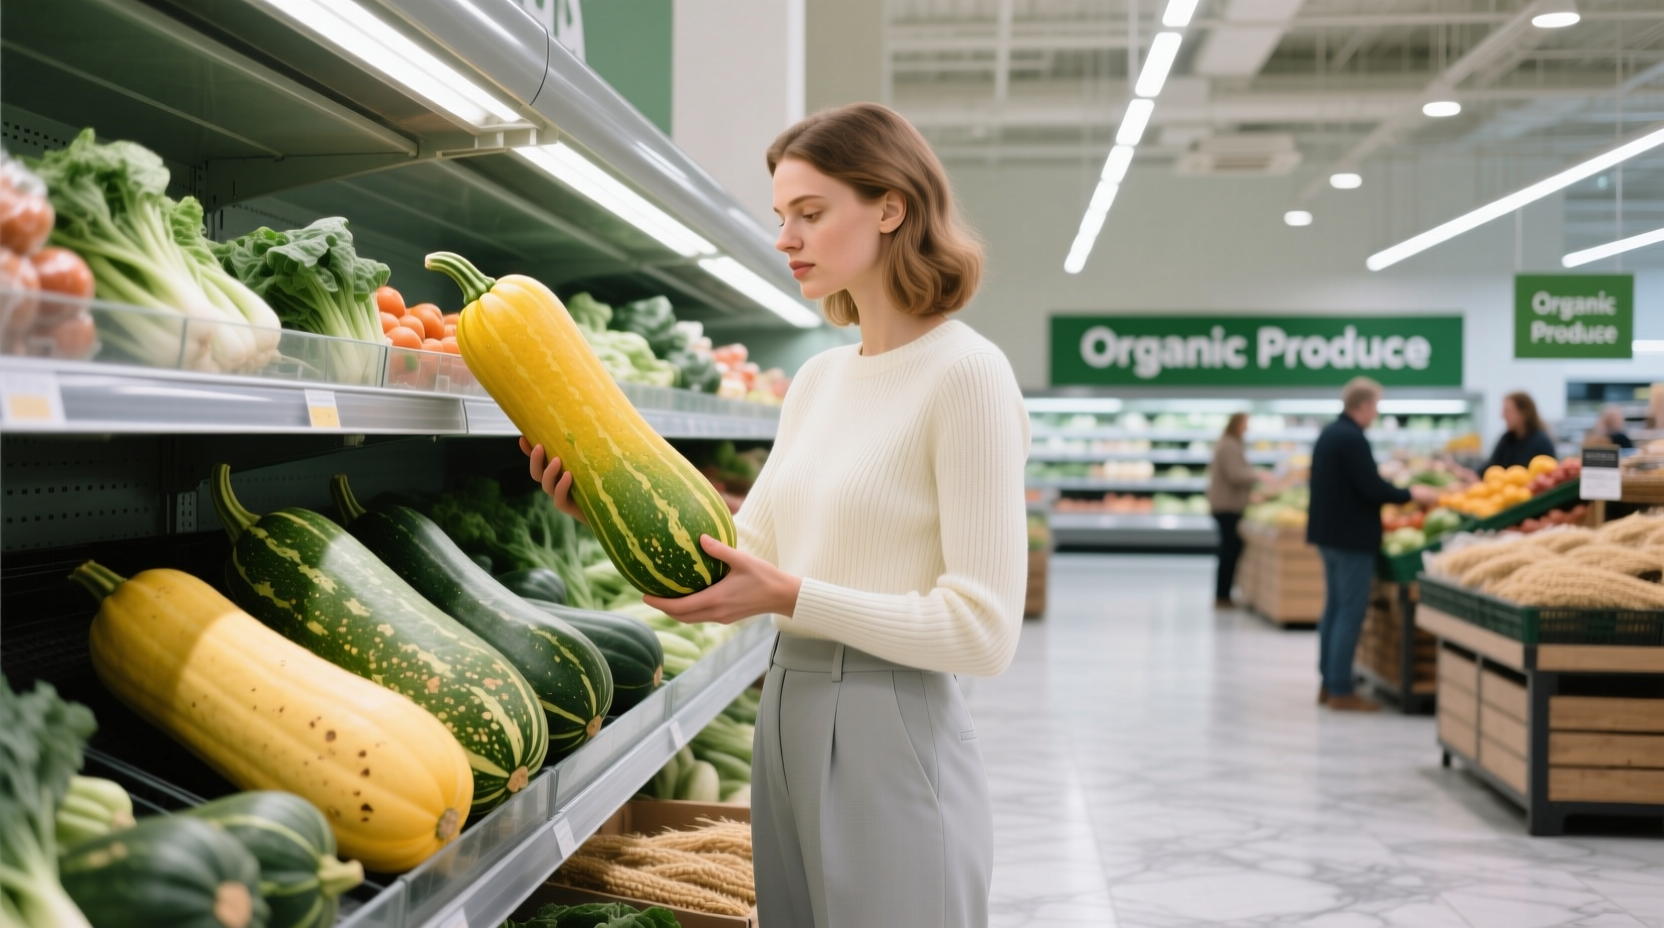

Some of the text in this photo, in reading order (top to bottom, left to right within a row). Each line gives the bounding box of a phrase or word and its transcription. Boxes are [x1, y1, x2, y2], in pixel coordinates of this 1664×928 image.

[1531, 291, 1616, 321] Organic
[1530, 320, 1618, 345] Produce
[1079, 324, 1432, 378] Organic Produce
